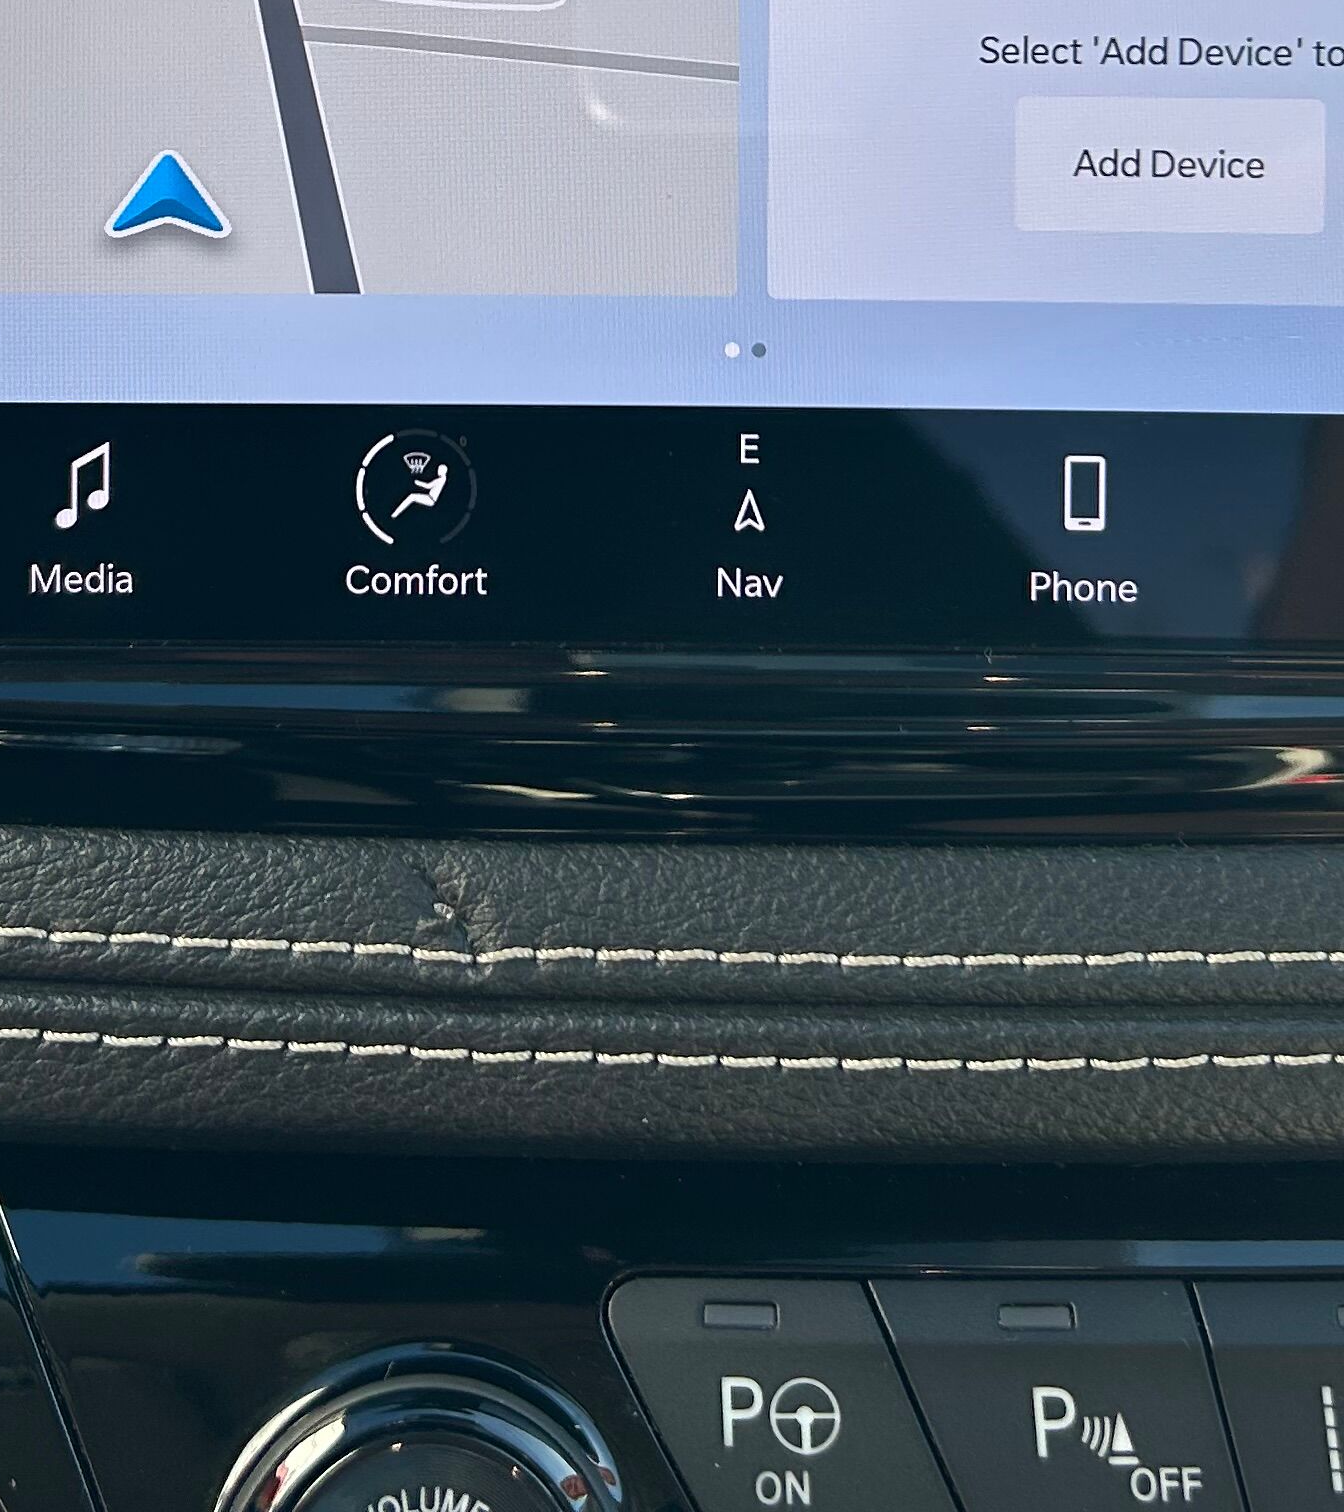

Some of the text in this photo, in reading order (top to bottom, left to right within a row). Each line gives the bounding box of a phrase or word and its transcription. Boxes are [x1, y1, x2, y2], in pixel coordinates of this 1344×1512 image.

[979, 35, 1083, 65] Select
[1093, 35, 1168, 65] 'Add
[1179, 37, 1302, 67] Device'
[1073, 148, 1265, 179] Add Device
[740, 433, 760, 464] E
[31, 562, 134, 594] Media
[345, 563, 488, 595] Comfort
[717, 567, 784, 598] Nav
[1030, 570, 1138, 603] Phone
[755, 1470, 811, 1505] ON
[1130, 1466, 1202, 1502] OFF
